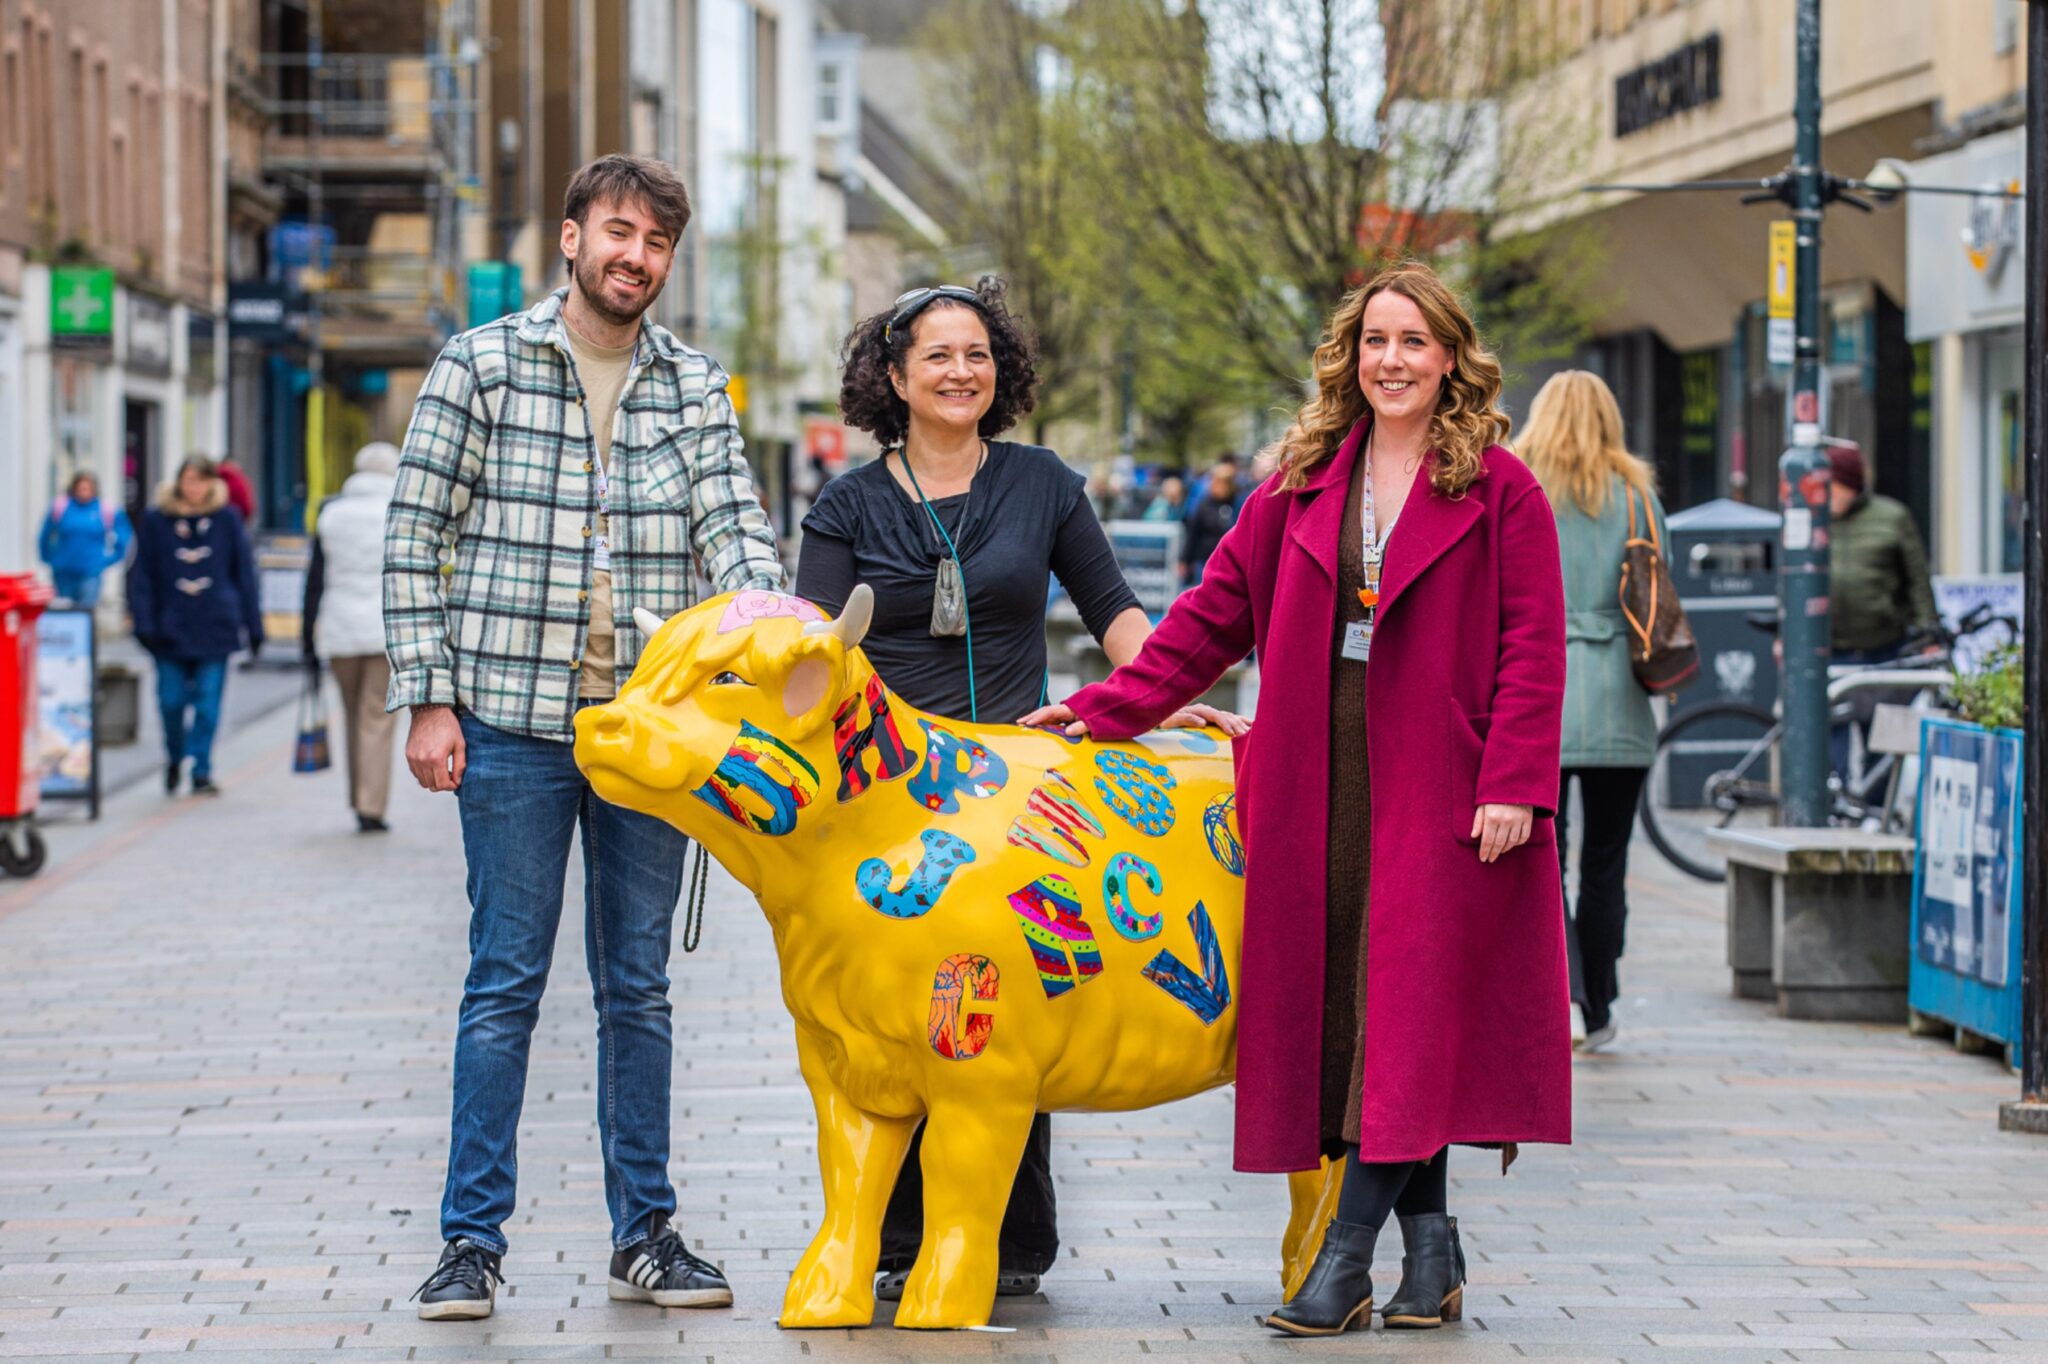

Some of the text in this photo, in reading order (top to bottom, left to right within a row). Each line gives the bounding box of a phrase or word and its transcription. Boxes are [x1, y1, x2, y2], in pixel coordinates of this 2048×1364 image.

[1093, 749, 1178, 838] S
[855, 828, 977, 921] J
[1102, 851, 1164, 942] C
[1140, 899, 1232, 1026] V
